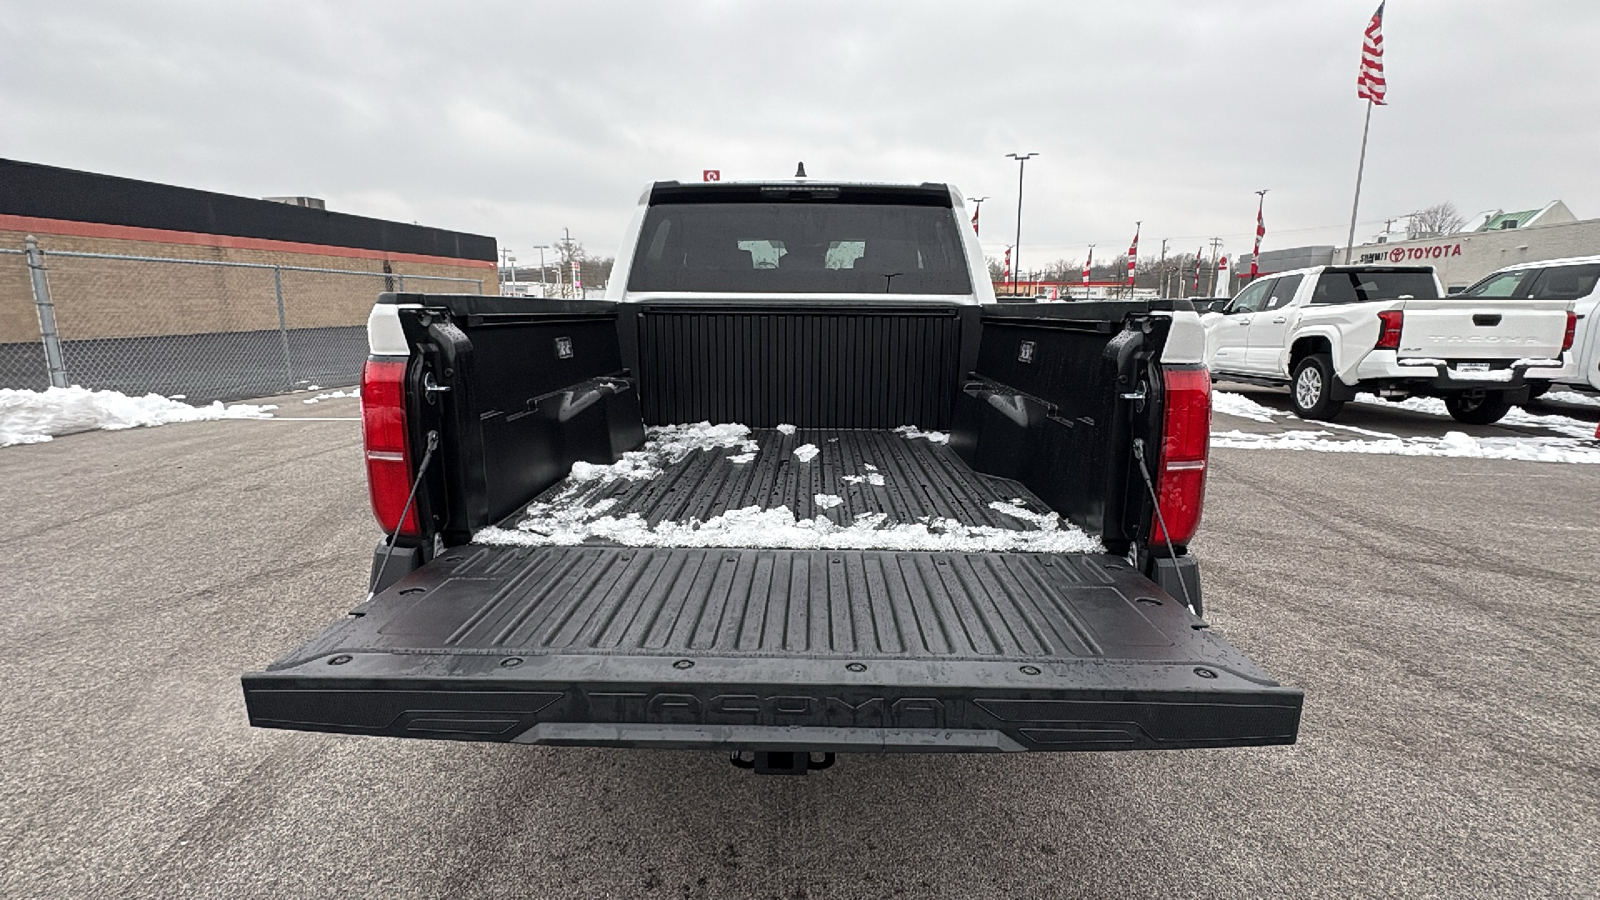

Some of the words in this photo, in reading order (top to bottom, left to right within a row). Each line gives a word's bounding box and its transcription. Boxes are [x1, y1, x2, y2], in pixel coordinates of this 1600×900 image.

[1406, 244, 1462, 260] TOYOTA
[1428, 334, 1540, 344] TACOMA
[586, 692, 946, 716] TACOMA
